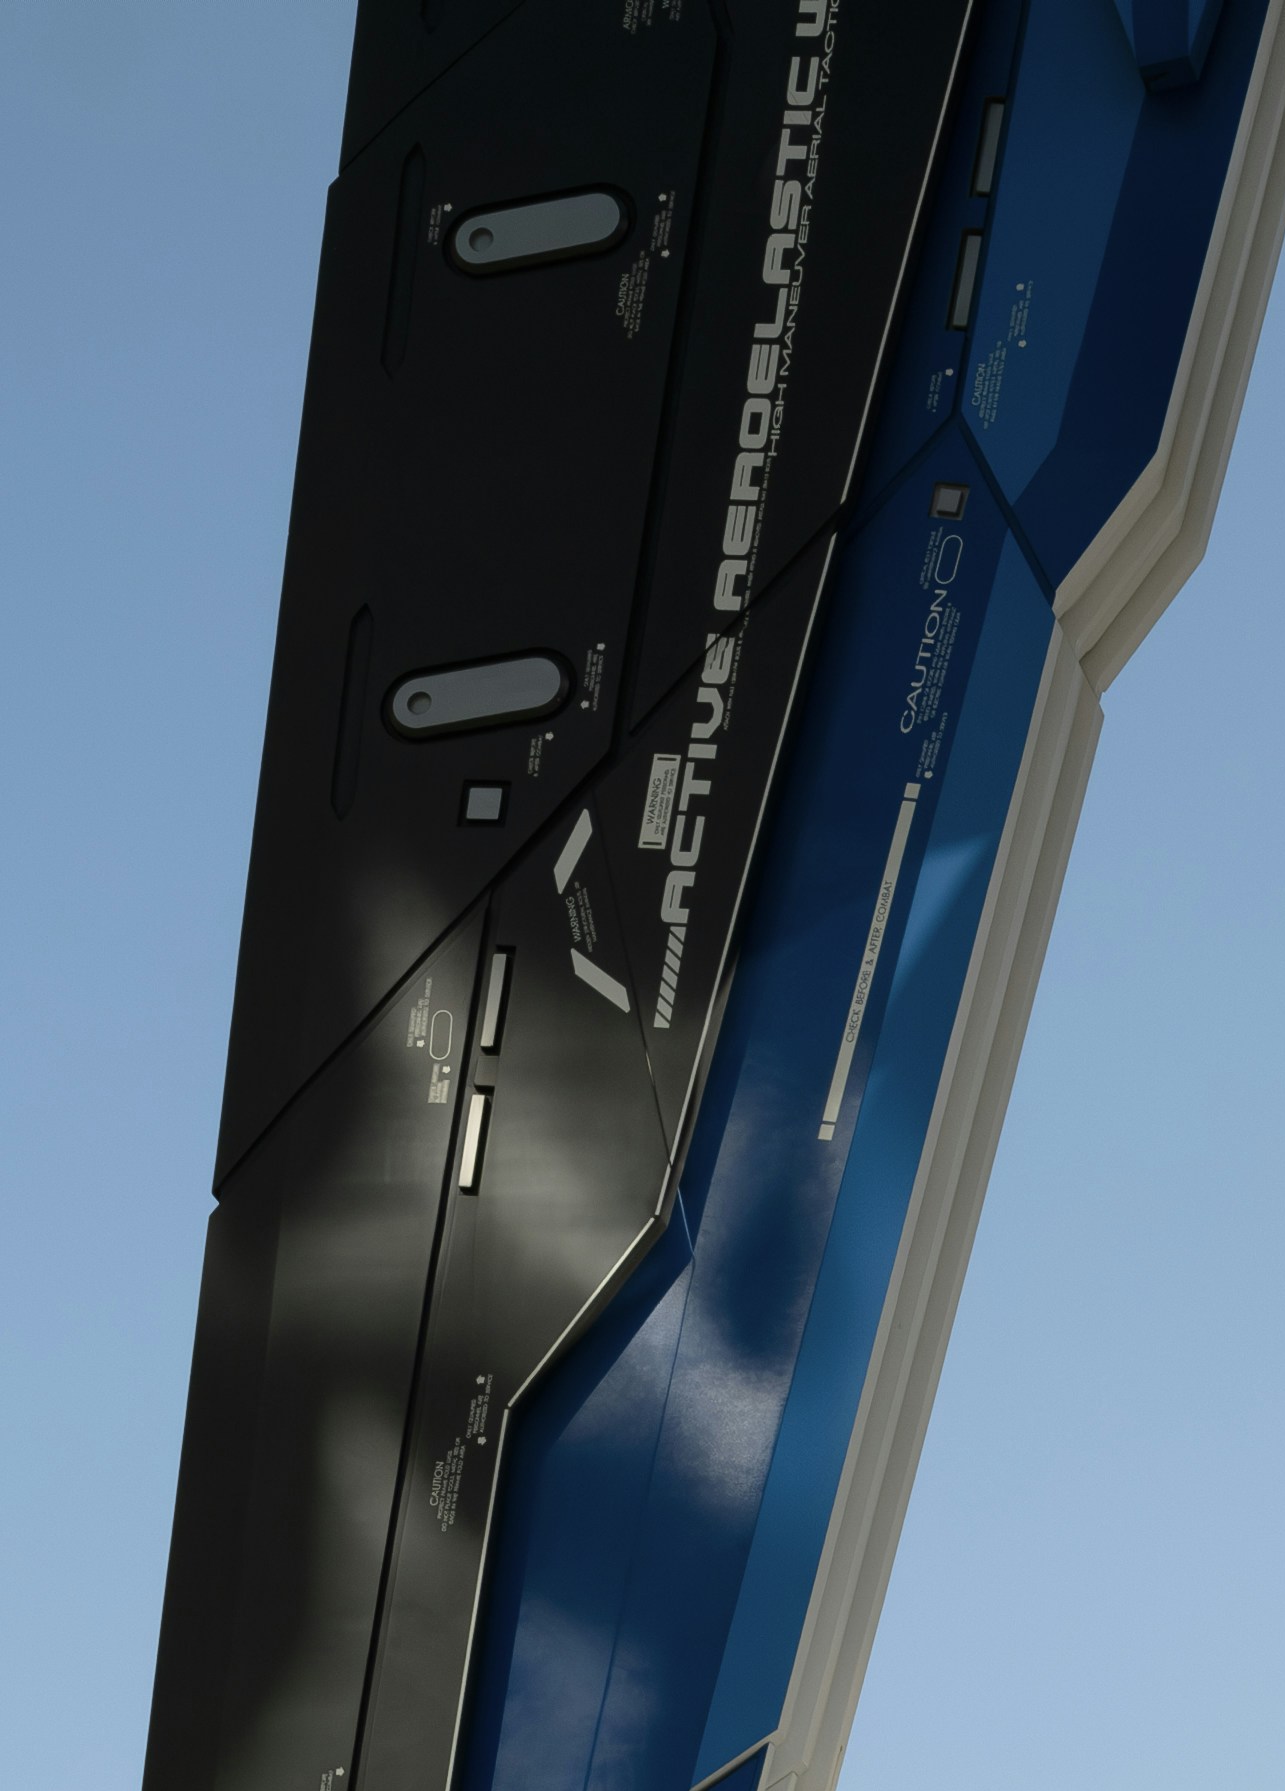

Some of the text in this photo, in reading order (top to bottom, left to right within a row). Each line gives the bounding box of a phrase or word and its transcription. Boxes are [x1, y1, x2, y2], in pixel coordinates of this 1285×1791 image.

[614, 272, 631, 316] CAUTION
[766, 380, 789, 457] HIGH
[778, 204, 815, 377] MANEUVER
[802, 93, 828, 199] AERIAL
[659, 632, 737, 926] ACTIVE
[714, 67, 822, 612] AEROELASTIC
[897, 589, 948, 733] CAUTION
[646, 776, 661, 825] WARNING
[874, 879, 895, 922] COMBAT
[866, 925, 883, 954] AFTER
[853, 969, 872, 1005] BEFORE
[844, 1008, 863, 1043] CHECK
[428, 1460, 445, 1506] CAUTION
